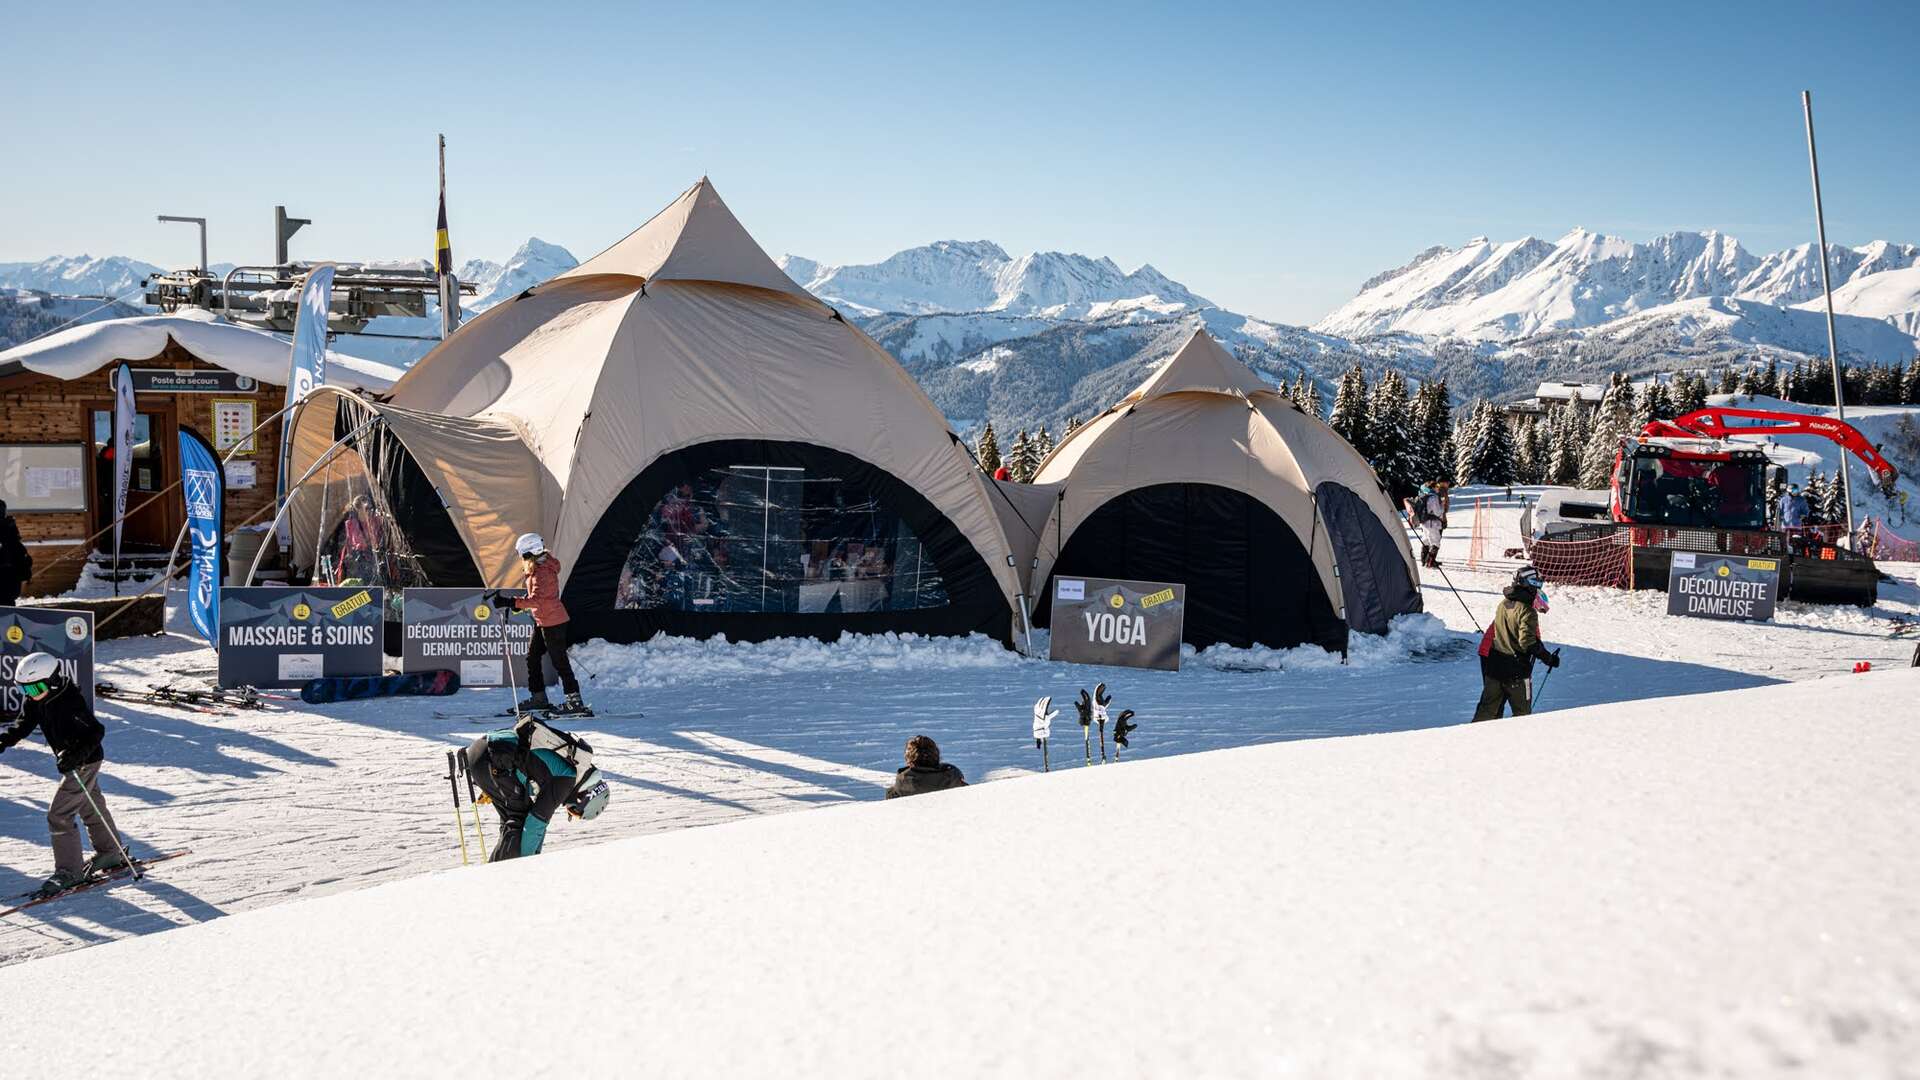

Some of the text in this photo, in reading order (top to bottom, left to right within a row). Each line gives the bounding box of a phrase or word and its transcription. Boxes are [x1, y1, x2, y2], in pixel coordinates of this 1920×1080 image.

[151, 376, 175, 385] Poste
[175, 376, 187, 385] de
[1679, 575, 1768, 600] DÉCOUVERTE
[335, 591, 369, 618] GRATUIT
[1143, 590, 1173, 608] GRATUIT
[1688, 596, 1755, 617] DAMEUSE
[229, 625, 374, 646] MASSAGE & SOINS
[407, 620, 535, 639] DÉCOUVERTE DES PROD
[1085, 612, 1147, 646] YOGA
[422, 639, 528, 656] DERMO-COSMÉTIQU
